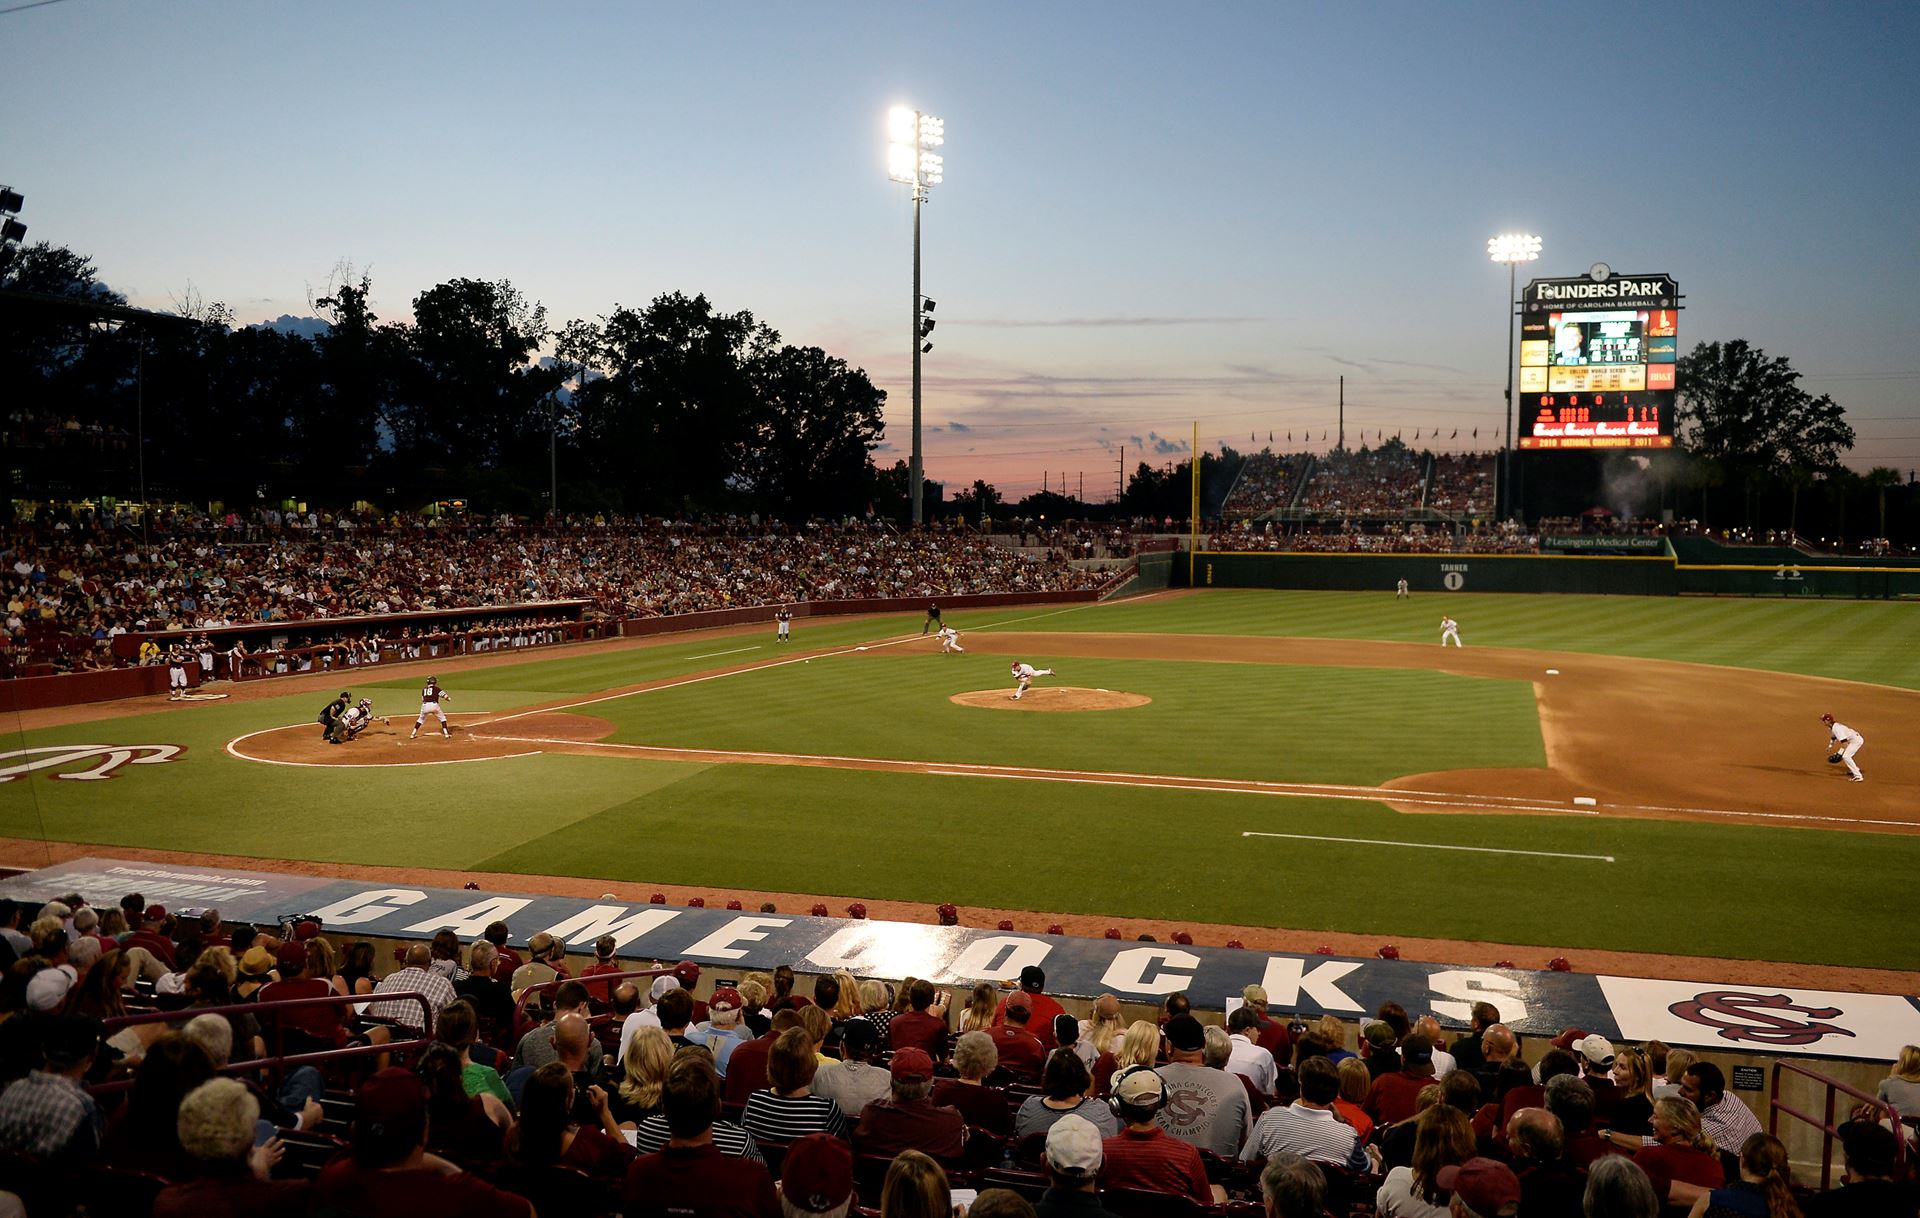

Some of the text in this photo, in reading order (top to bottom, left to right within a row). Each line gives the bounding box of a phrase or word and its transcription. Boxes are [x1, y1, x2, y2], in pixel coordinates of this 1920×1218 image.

[1537, 280, 1663, 300] FOUNDERS PARK
[1561, 438, 1591, 447] NATIONAL
[1593, 438, 1631, 447] CHAMPIONS
[1553, 538, 1658, 548] Lexington Medical Center
[1440, 564, 1468, 572] TANNER
[1449, 574, 1456, 587] 1
[423, 687, 433, 697] 18
